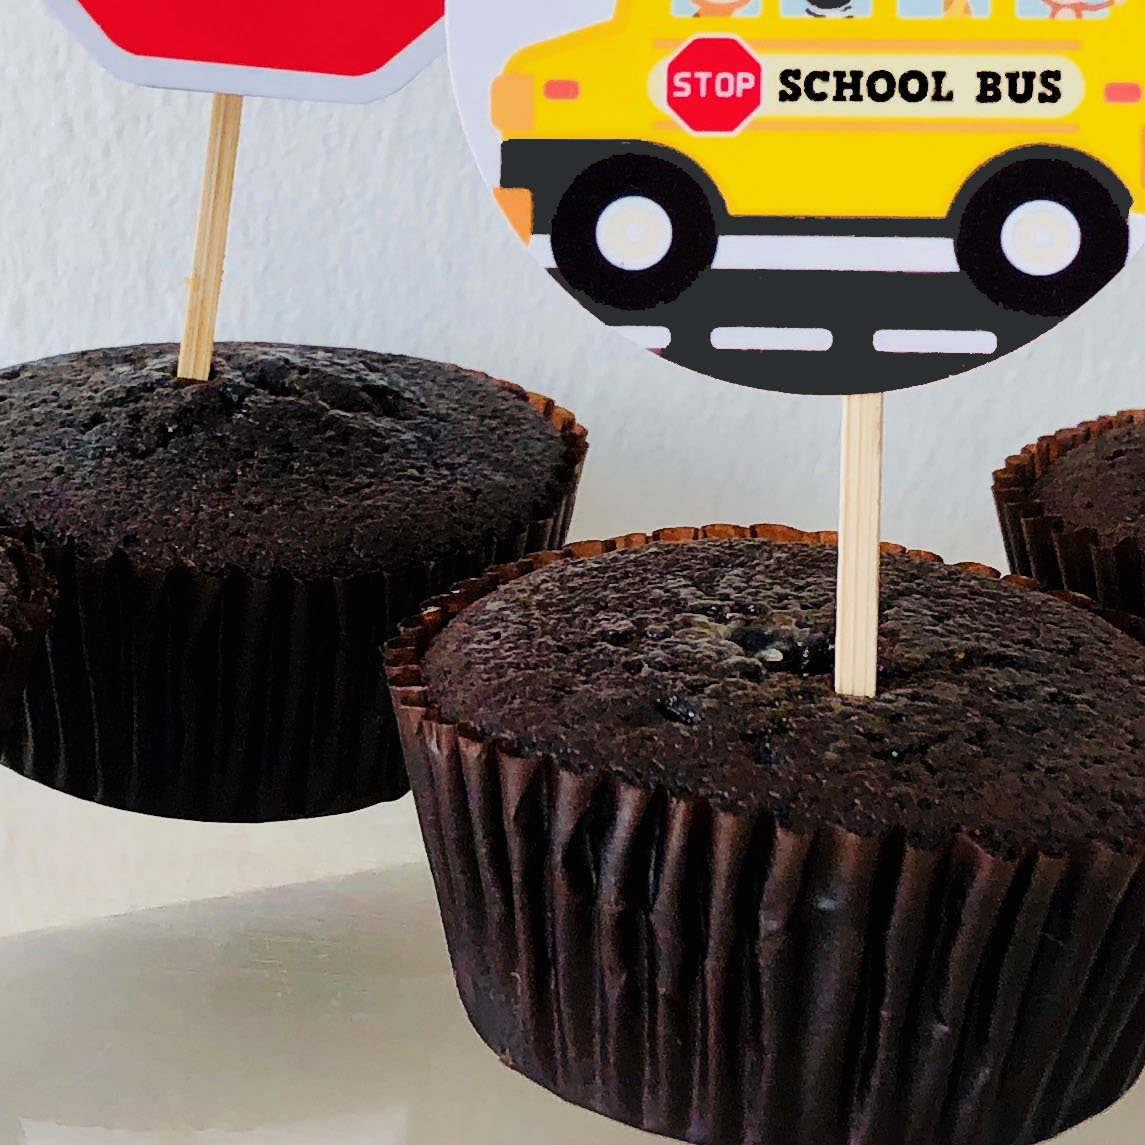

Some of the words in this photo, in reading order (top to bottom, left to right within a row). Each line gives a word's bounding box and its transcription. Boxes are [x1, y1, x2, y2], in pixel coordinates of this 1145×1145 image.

[672, 70, 756, 99] STOP
[778, 68, 954, 104] SCHOOL
[975, 68, 1062, 104] BUS
